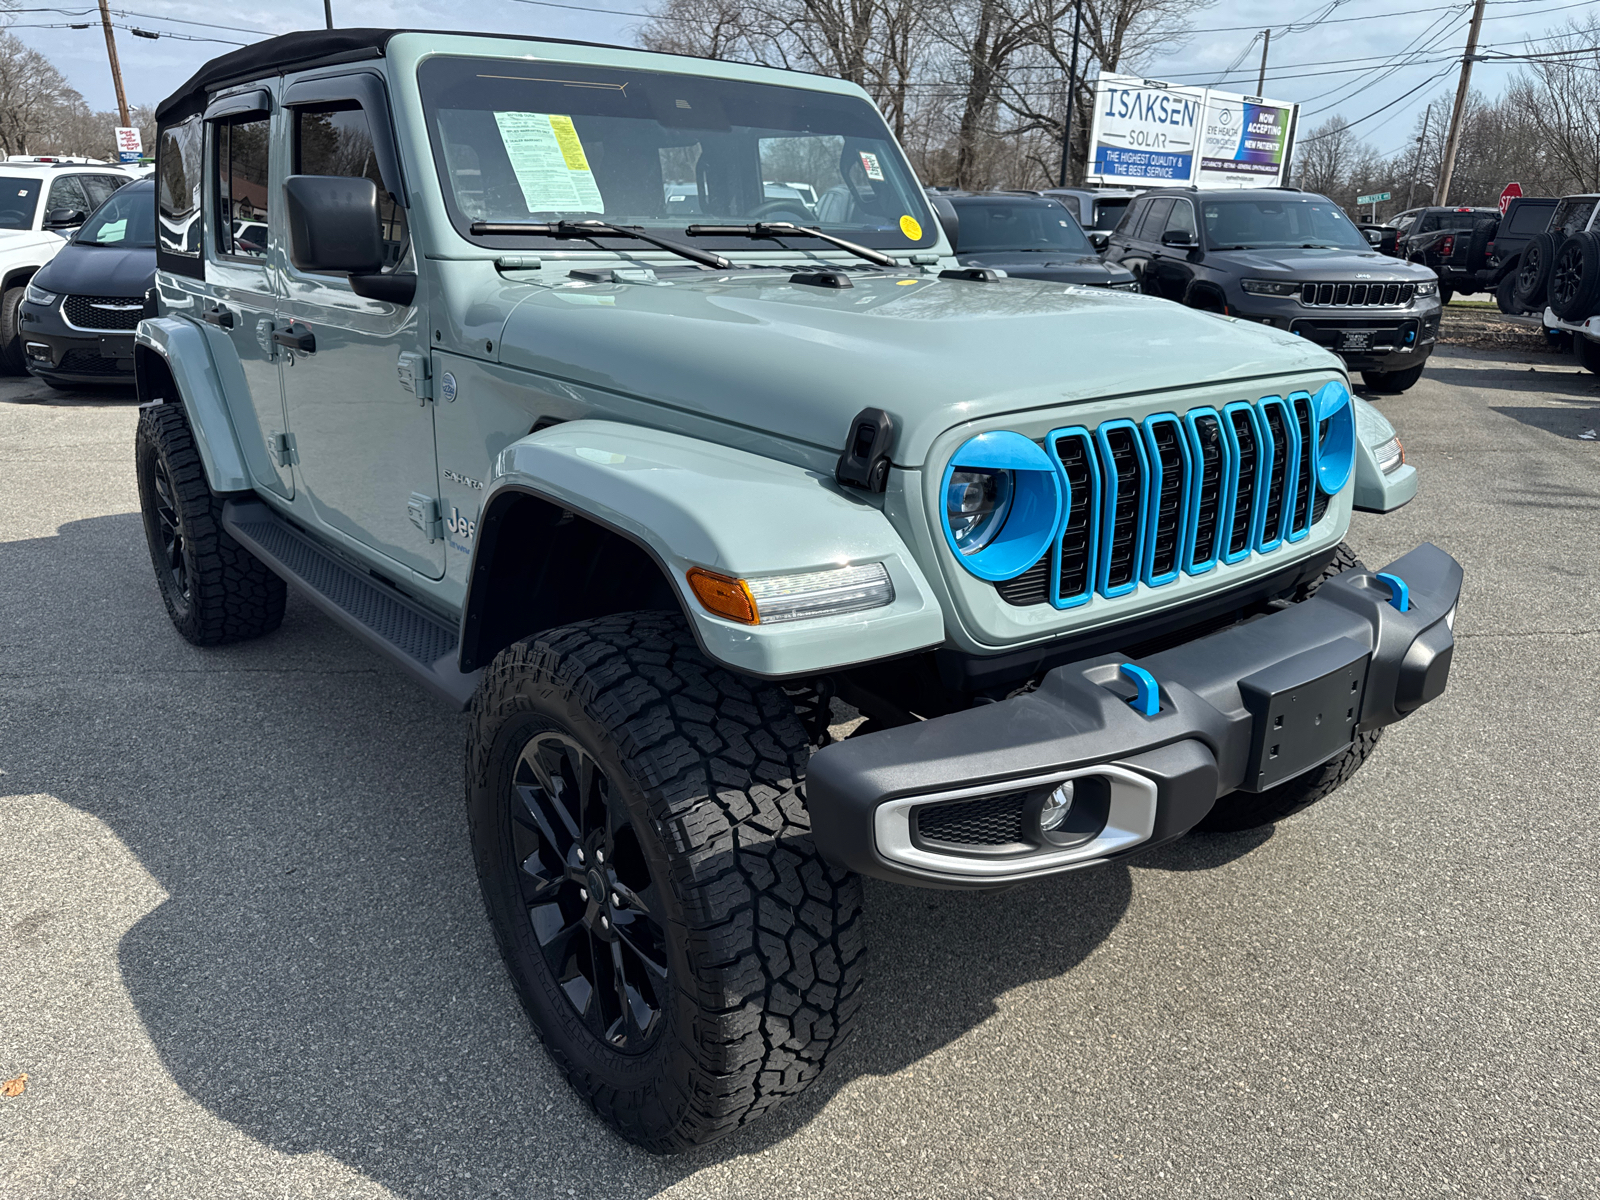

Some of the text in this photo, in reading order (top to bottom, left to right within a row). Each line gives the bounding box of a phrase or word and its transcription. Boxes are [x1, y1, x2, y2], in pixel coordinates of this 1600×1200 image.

[1105, 88, 1197, 127] ISAKSEN
[1258, 112, 1275, 124] NOW
[1207, 125, 1238, 137] EYE HEALTH
[1247, 122, 1282, 136] ACCEPTING
[1128, 129, 1168, 148] SOLAR
[1244, 140, 1256, 149] NEW
[1106, 150, 1183, 167] THE HIGHEST QUALITY &
[1114, 163, 1174, 178] THE BEST SERVICE
[443, 469, 484, 490] SAHARA
[447, 506, 475, 540] Jee
